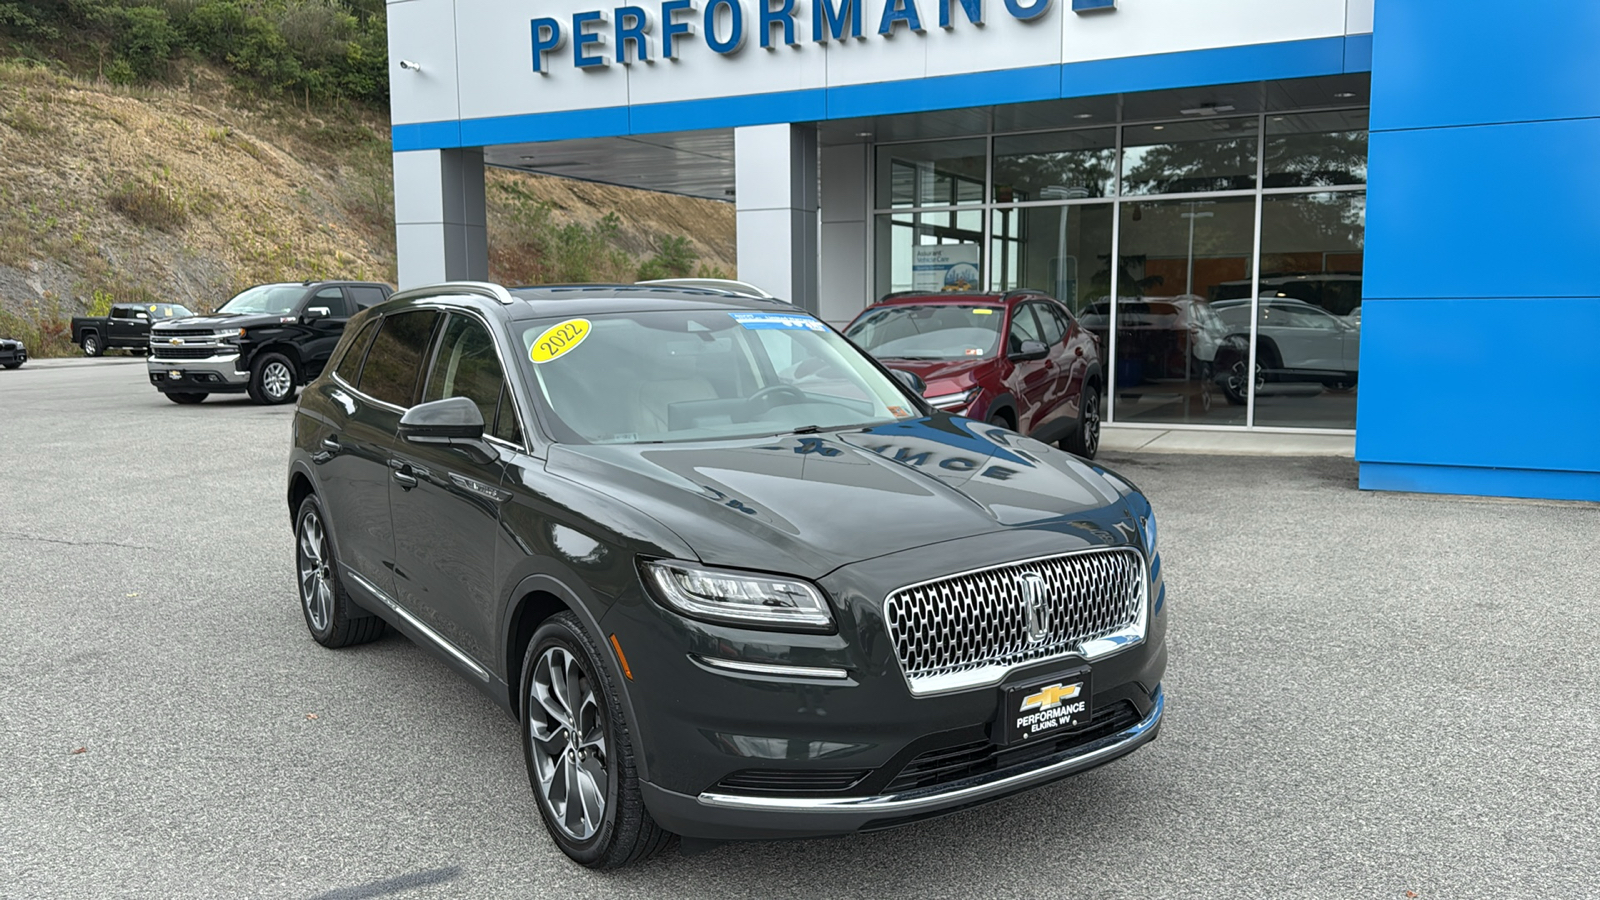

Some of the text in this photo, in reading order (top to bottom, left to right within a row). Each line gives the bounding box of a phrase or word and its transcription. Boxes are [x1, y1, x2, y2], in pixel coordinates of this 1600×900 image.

[530, 0, 1117, 73] PERFORMA
[540, 323, 583, 356] 2022
[1016, 701, 1085, 728] PERFORMANCE
[1031, 715, 1071, 732] ELKINS, WV
